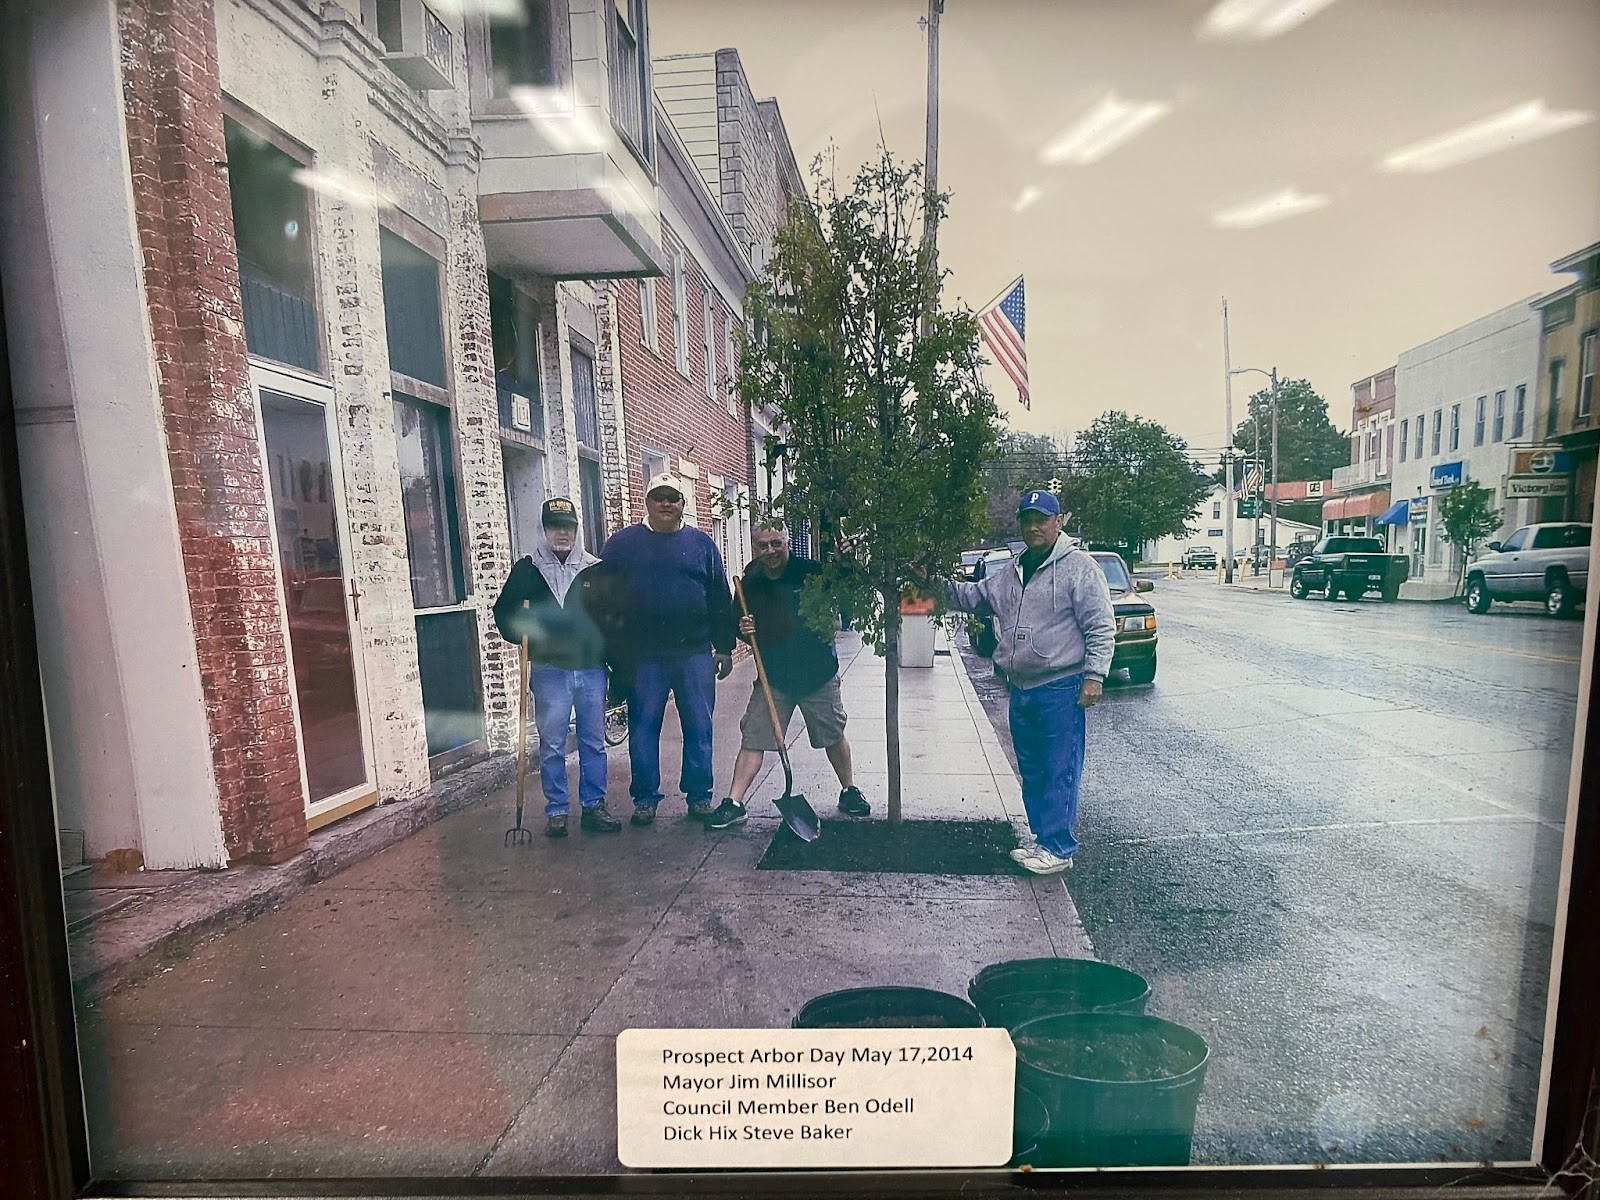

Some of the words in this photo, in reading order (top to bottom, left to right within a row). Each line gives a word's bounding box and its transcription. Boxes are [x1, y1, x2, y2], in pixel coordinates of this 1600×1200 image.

[662, 1048, 745, 1066] Prospect
[749, 1048, 805, 1064] Arbor
[810, 1047, 846, 1067] Day
[851, 1047, 893, 1067] May
[898, 1046, 974, 1065] 17,2014
[663, 1074, 725, 1094] Mayor
[728, 1074, 760, 1090] Jim
[766, 1073, 837, 1089] Millisor
[663, 1099, 732, 1116] Council
[737, 1098, 819, 1115] Member
[824, 1099, 860, 1114] Ben
[865, 1097, 914, 1114] Odell
[664, 1125, 703, 1141] Dick
[709, 1125, 738, 1141] Hix
[743, 1124, 794, 1141] Steve
[800, 1123, 853, 1140] Baker
